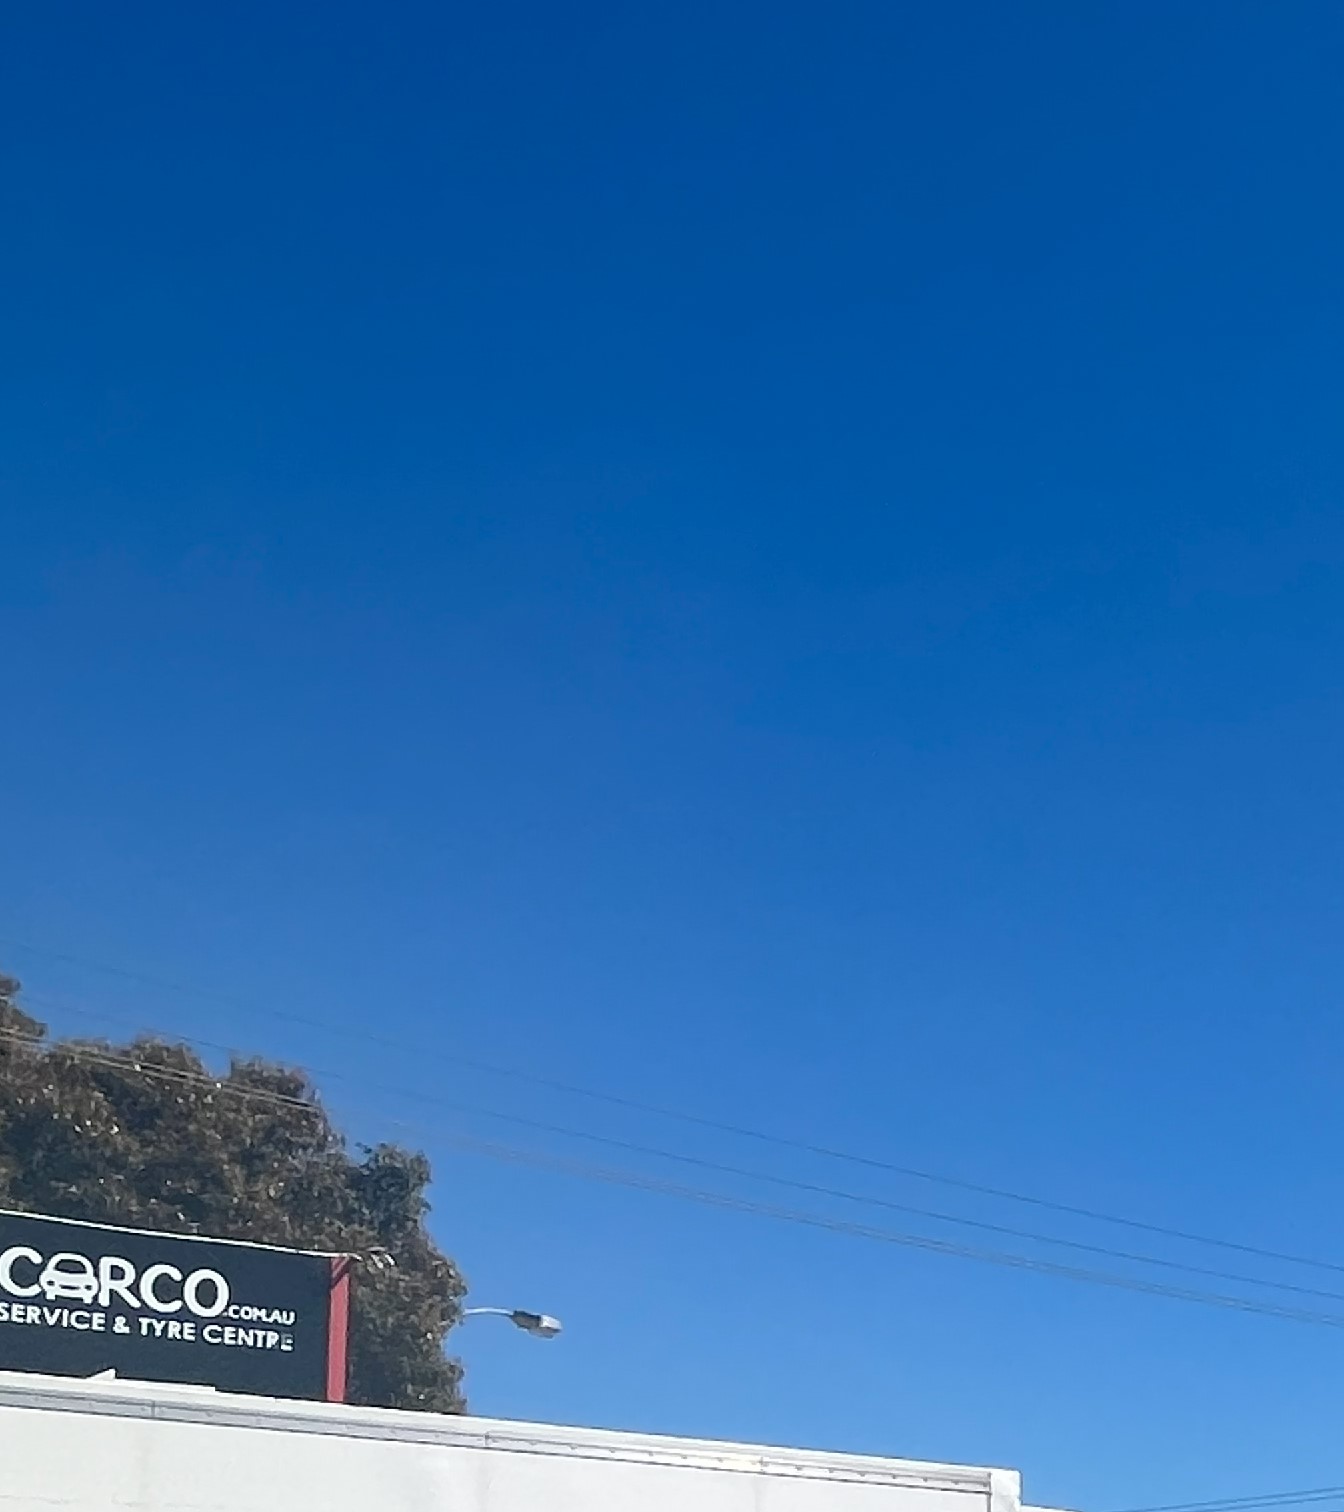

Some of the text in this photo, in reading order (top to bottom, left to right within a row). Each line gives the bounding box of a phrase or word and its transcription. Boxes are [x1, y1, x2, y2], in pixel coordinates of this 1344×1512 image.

[0, 1303, 106, 1332] SERVICE
[112, 1316, 131, 1334] &
[138, 1317, 196, 1342] TYRE
